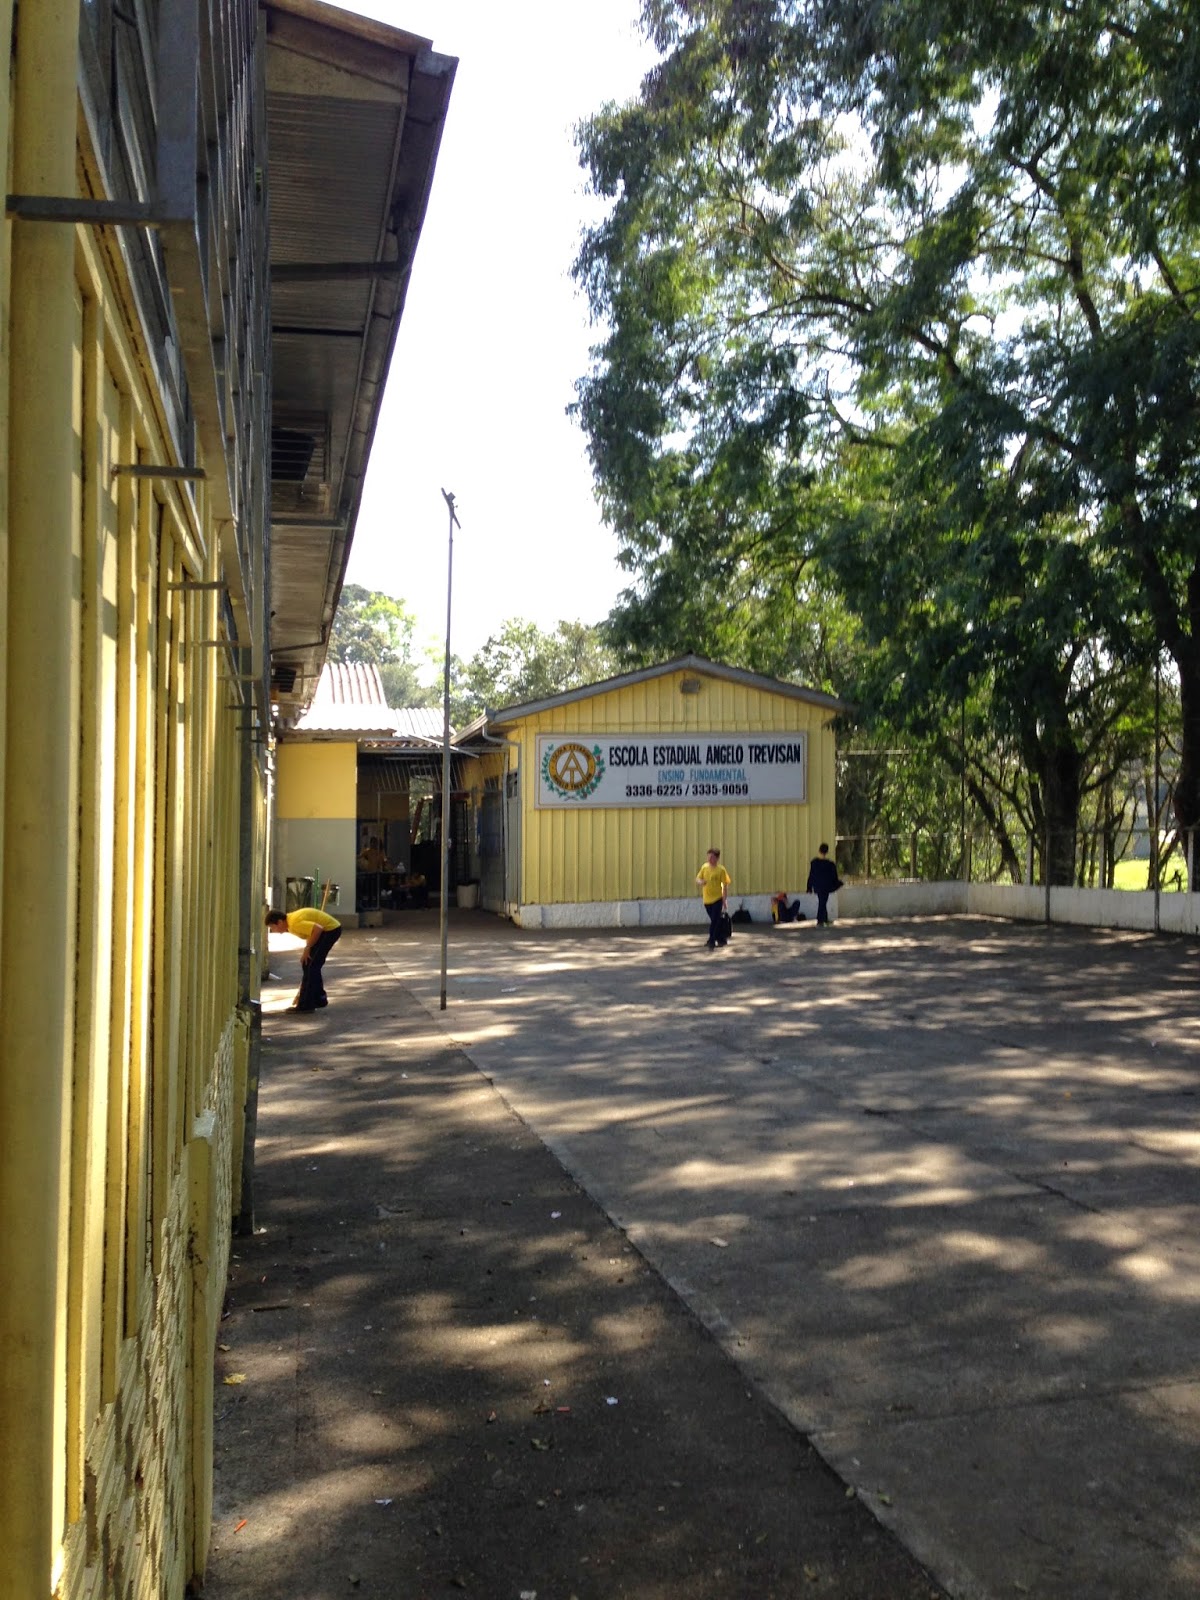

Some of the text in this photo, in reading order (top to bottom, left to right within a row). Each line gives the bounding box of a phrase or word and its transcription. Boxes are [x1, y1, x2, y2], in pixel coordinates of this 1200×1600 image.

[609, 745, 648, 766] ESCOLA
[653, 744, 702, 766] ESTADUAL
[706, 744, 743, 765] ANGELO
[748, 743, 801, 764] TREVISAN
[657, 768, 747, 783] ENSINO FUNDAMENTAL
[626, 785, 683, 797] 3336-6225
[692, 784, 749, 797] 3335-9059
